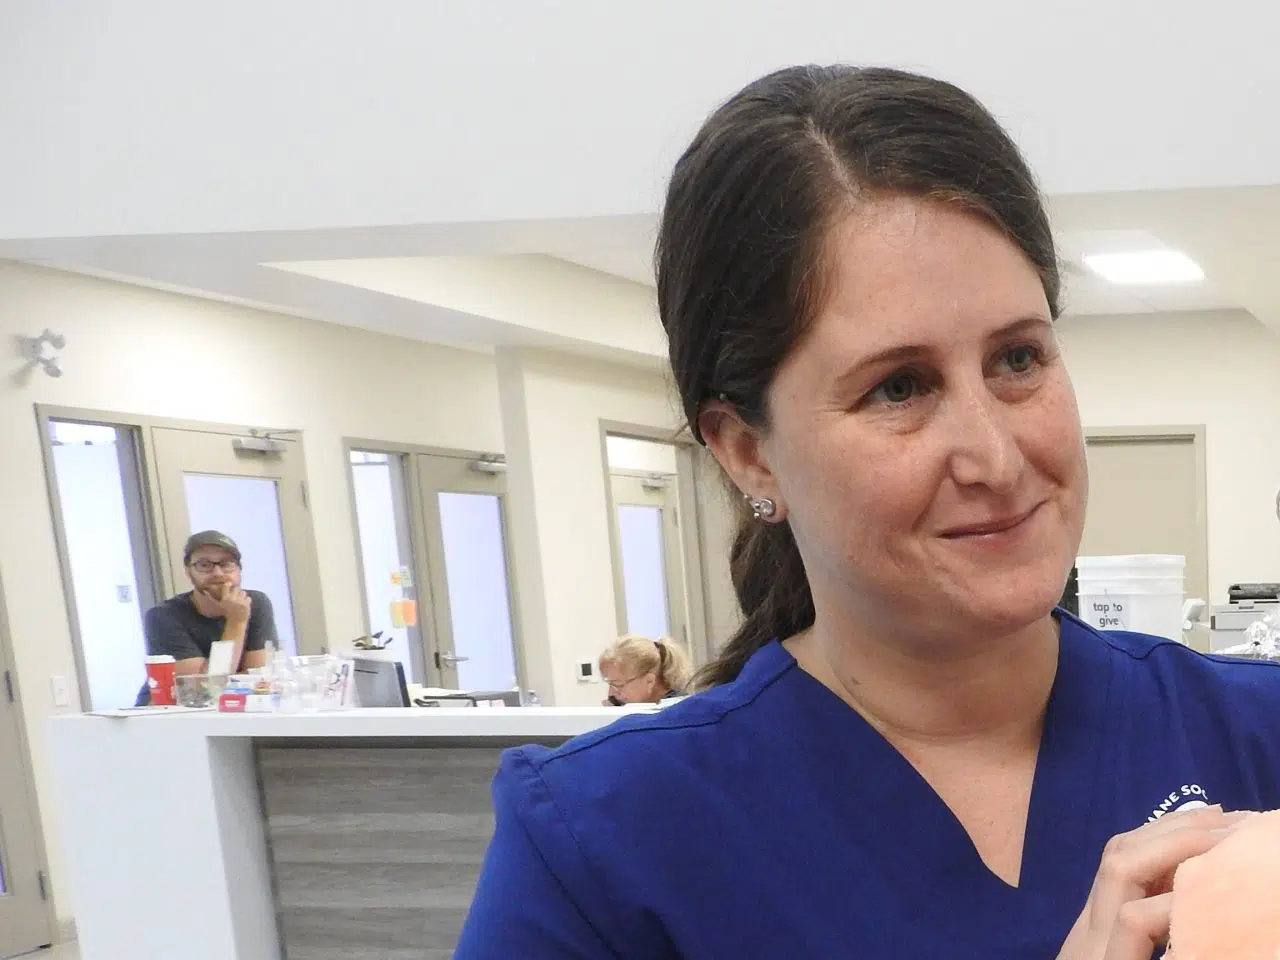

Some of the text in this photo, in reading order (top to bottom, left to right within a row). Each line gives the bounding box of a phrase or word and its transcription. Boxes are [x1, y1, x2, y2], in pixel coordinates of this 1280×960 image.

[1092, 602, 1123, 614] tap to
[1099, 614, 1119, 628] give
